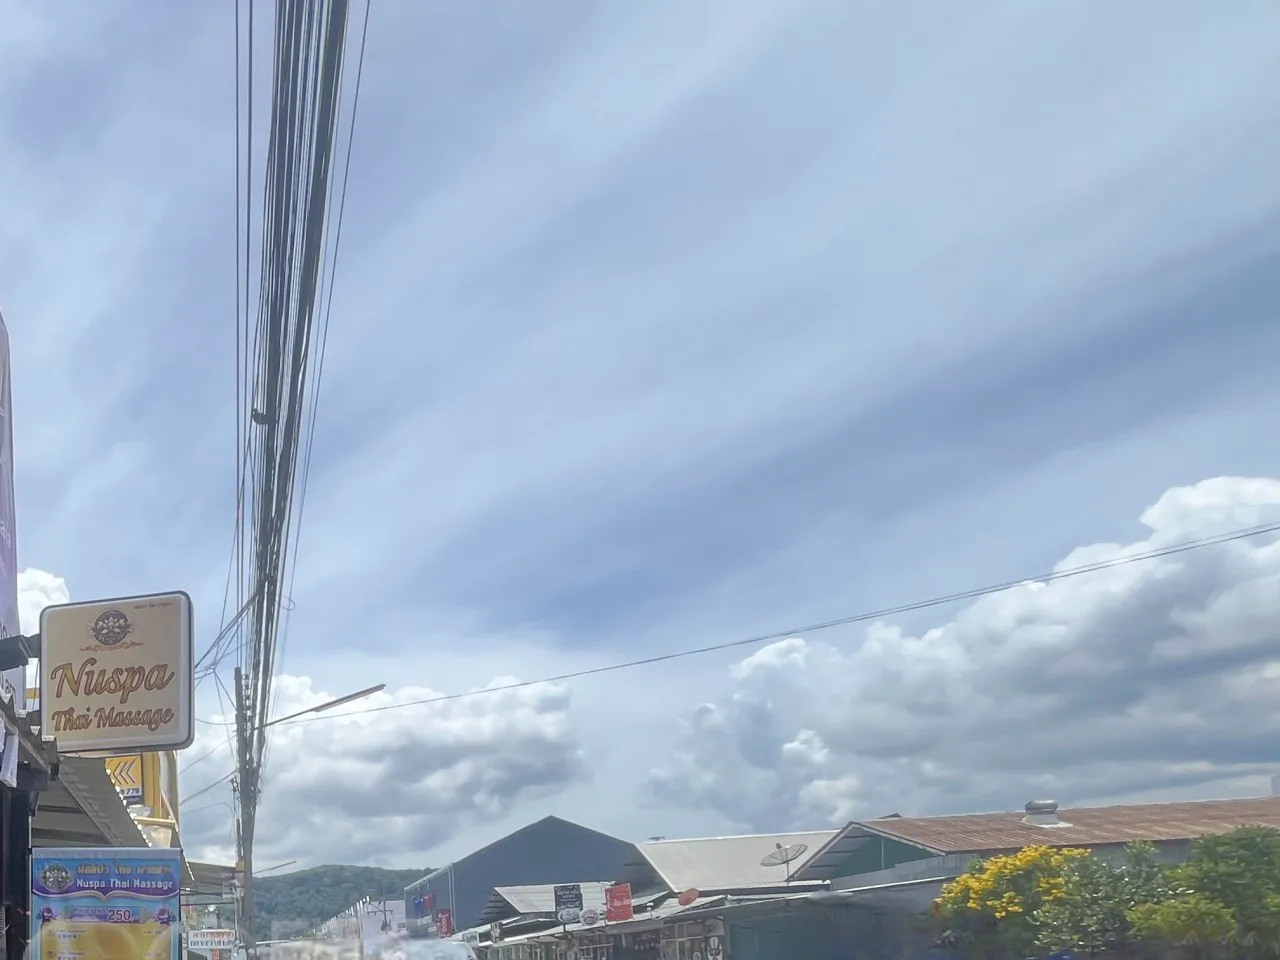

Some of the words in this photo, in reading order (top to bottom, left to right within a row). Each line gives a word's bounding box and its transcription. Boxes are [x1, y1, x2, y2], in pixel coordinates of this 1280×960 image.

[50, 657, 175, 704] Nuspa
[51, 706, 92, 732] Thai
[94, 706, 175, 732] Massage
[76, 878, 105, 889] Nuspa
[109, 878, 130, 888] Thai
[133, 878, 173, 890] Massage
[108, 909, 131, 921] 250
